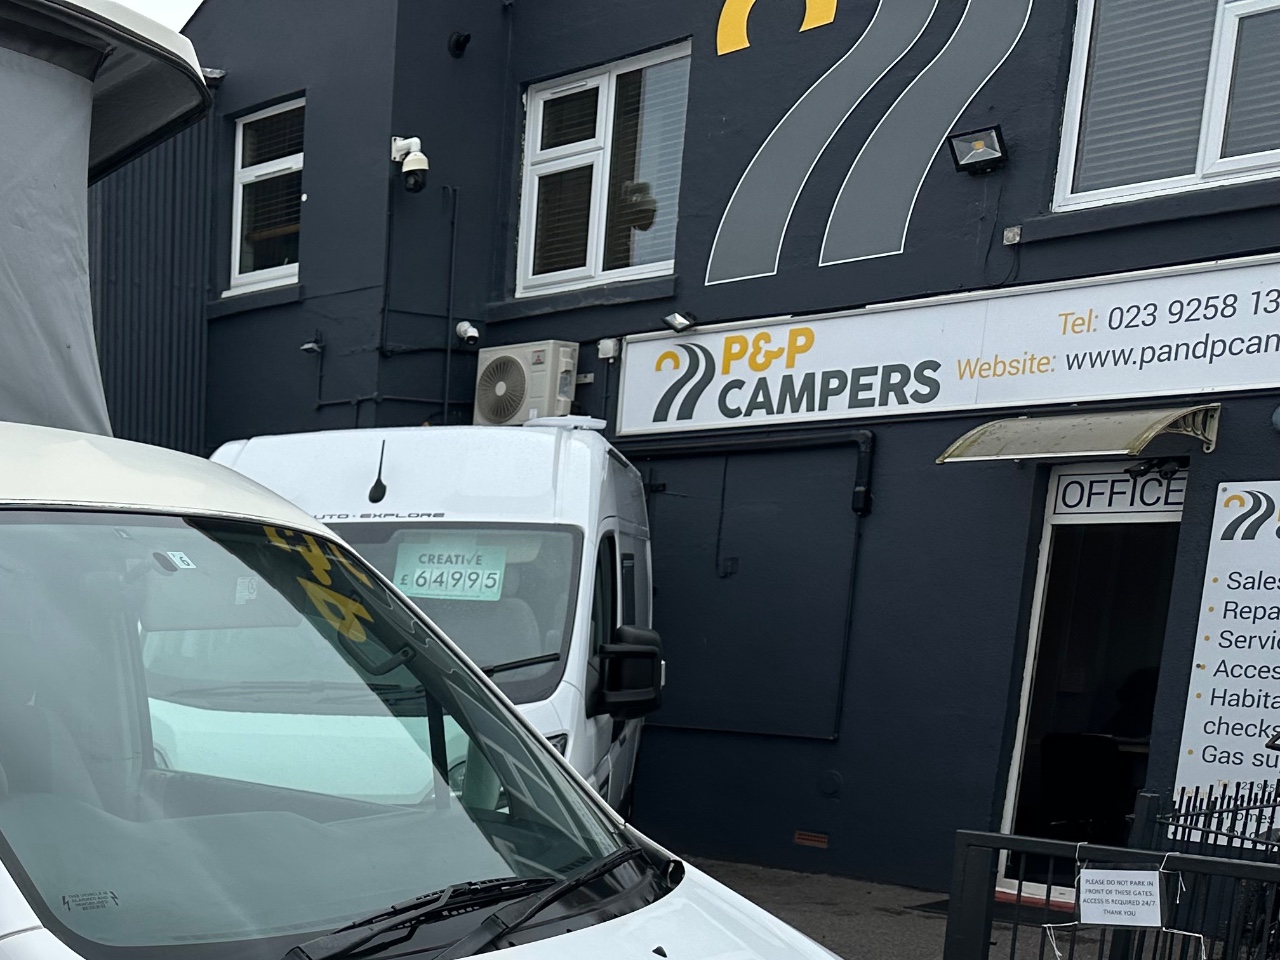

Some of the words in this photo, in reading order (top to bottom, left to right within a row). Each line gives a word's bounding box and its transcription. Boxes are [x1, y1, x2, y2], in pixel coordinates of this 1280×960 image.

[1058, 308, 1099, 336] Tel:
[1108, 302, 1158, 331] 023
[1168, 293, 1238, 324] 9258
[1251, 288, 1280, 316] 13
[721, 327, 815, 375] P&P
[956, 351, 1057, 381] Website:
[717, 359, 942, 419] CAMPERS
[1061, 477, 1187, 509] OFFICE
[418, 549, 483, 566] CREATIVE
[1222, 600, 1280, 625] Repa
[1202, 745, 1244, 766] Gas
[1251, 752, 1280, 770] su
[1085, 878, 1105, 886] PLEASE
